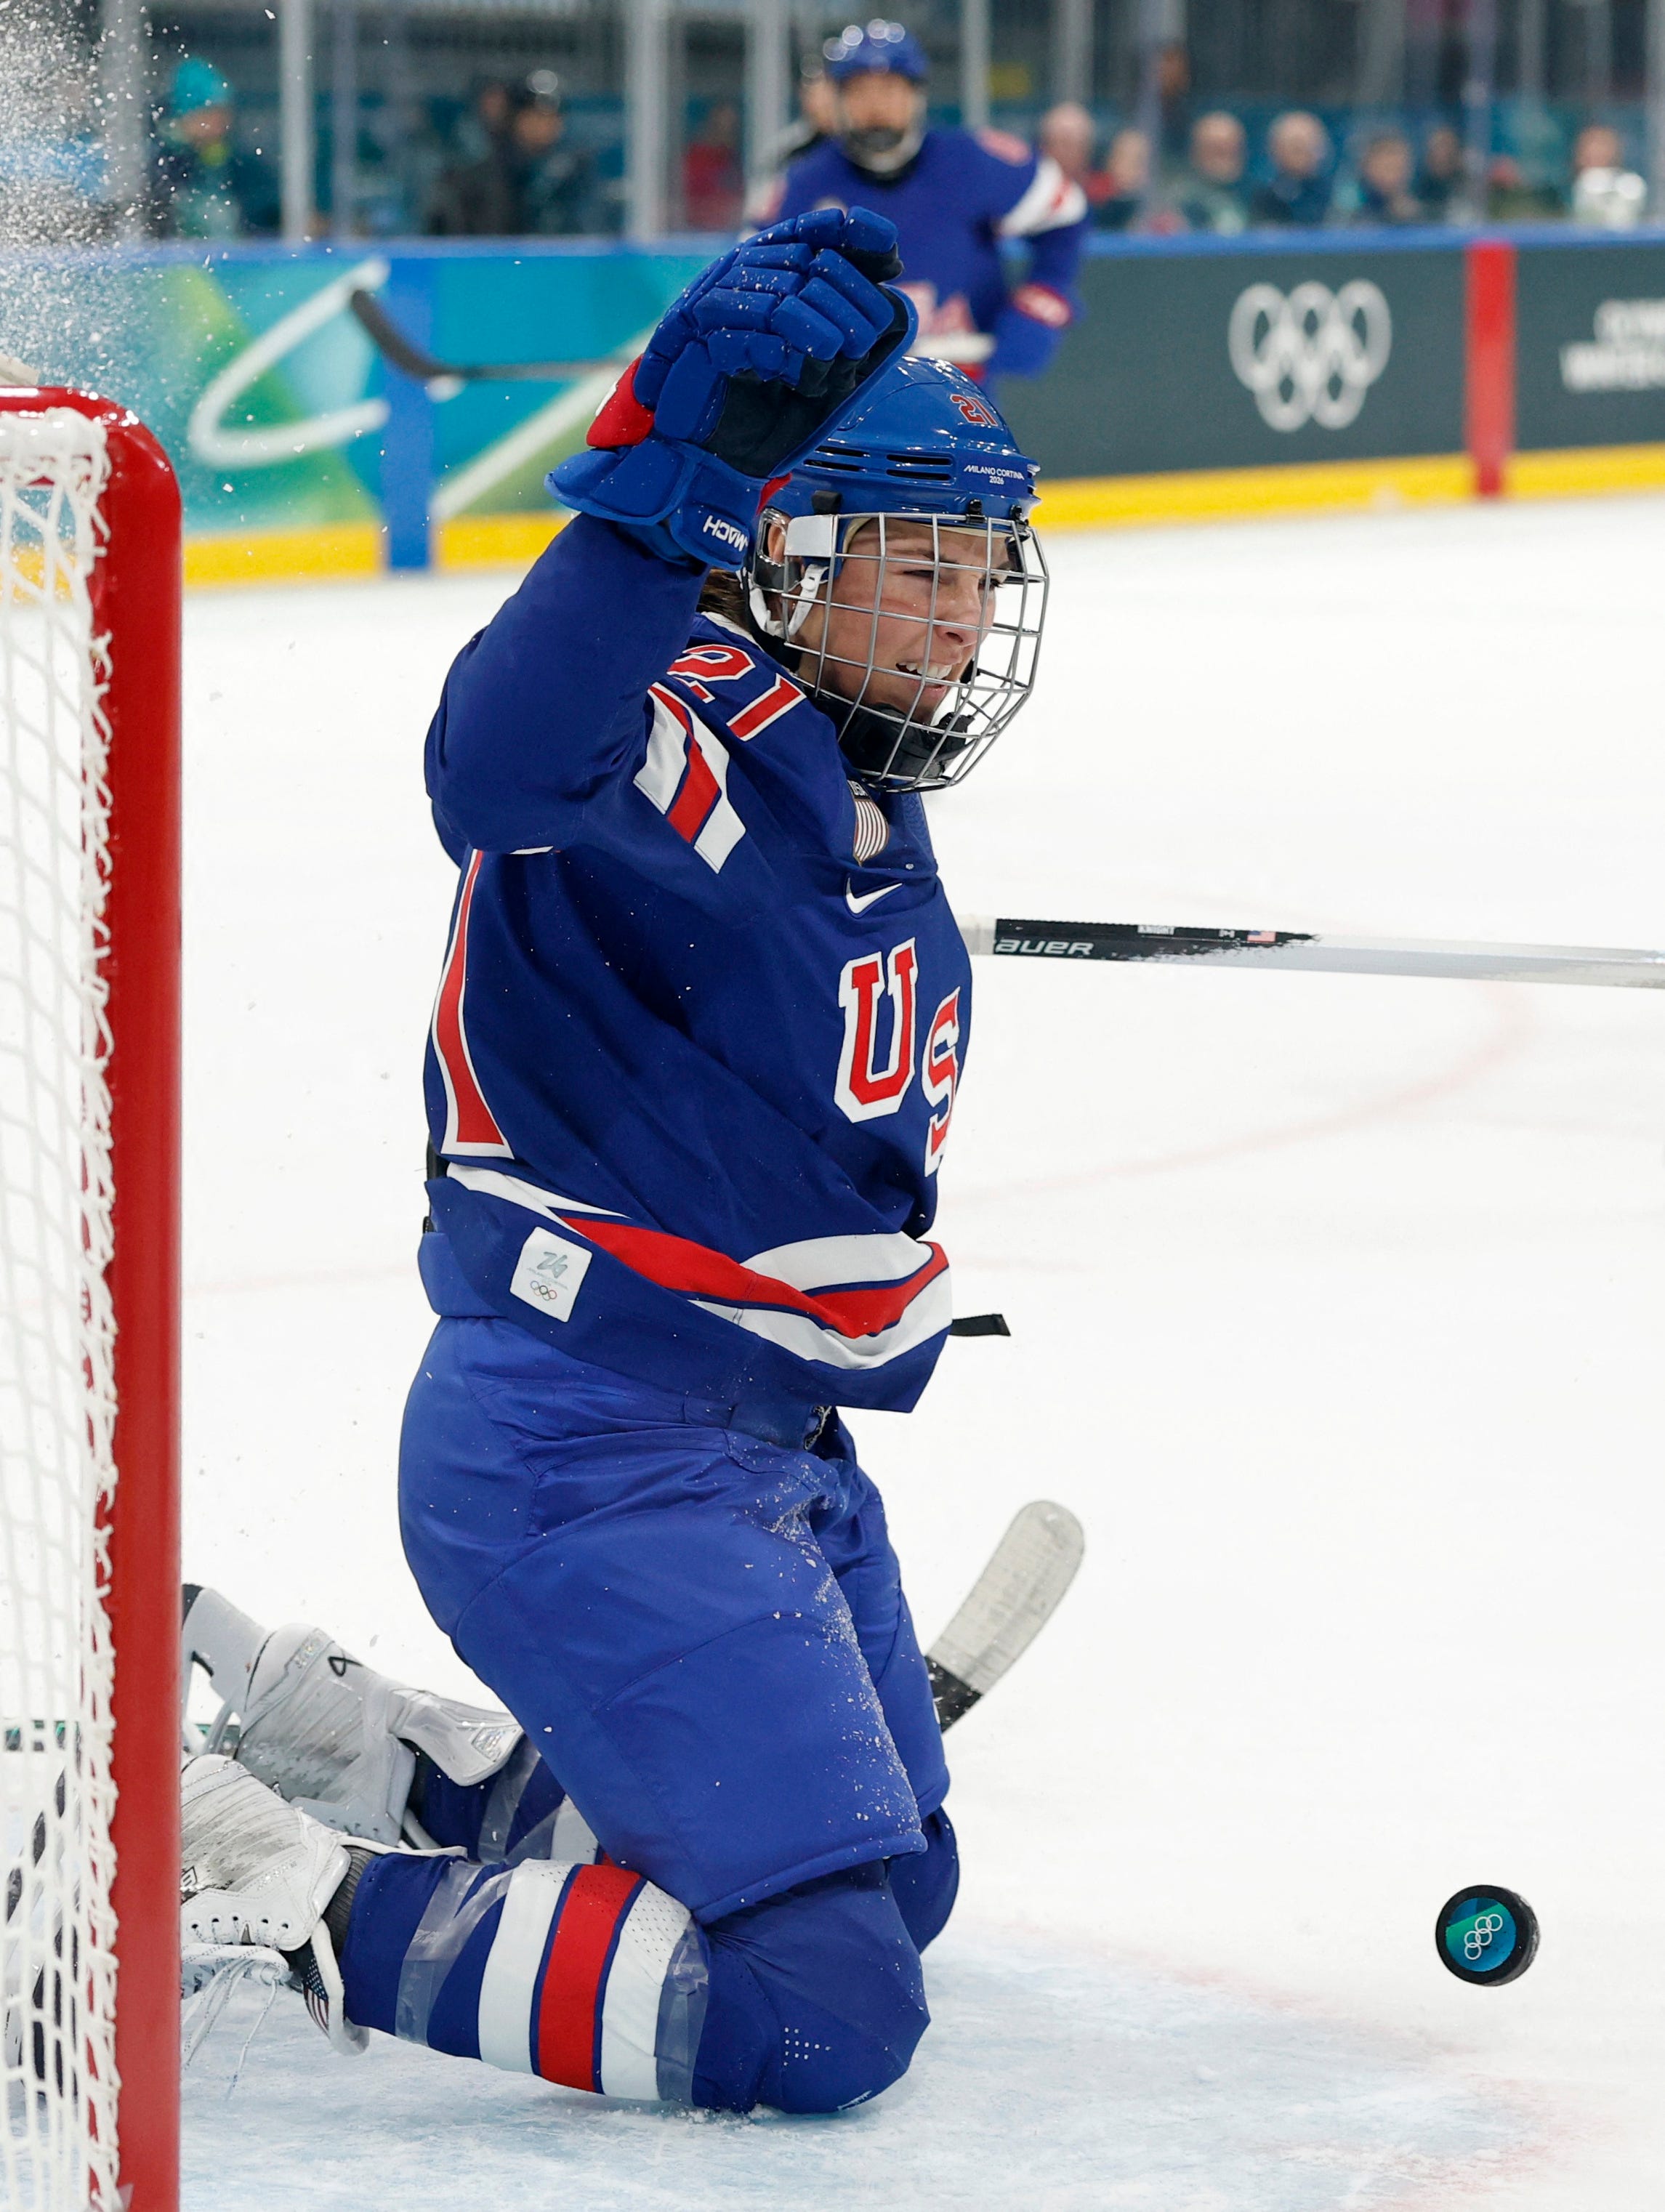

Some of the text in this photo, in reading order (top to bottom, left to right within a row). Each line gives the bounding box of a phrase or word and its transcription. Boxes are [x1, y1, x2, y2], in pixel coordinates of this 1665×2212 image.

[950, 394, 999, 427] 21
[964, 464, 1025, 480] MILANO CORTINA
[989, 475, 1004, 485] 2026
[703, 514, 749, 552] MACH
[666, 644, 807, 742] 21
[995, 938, 1094, 956] AUER
